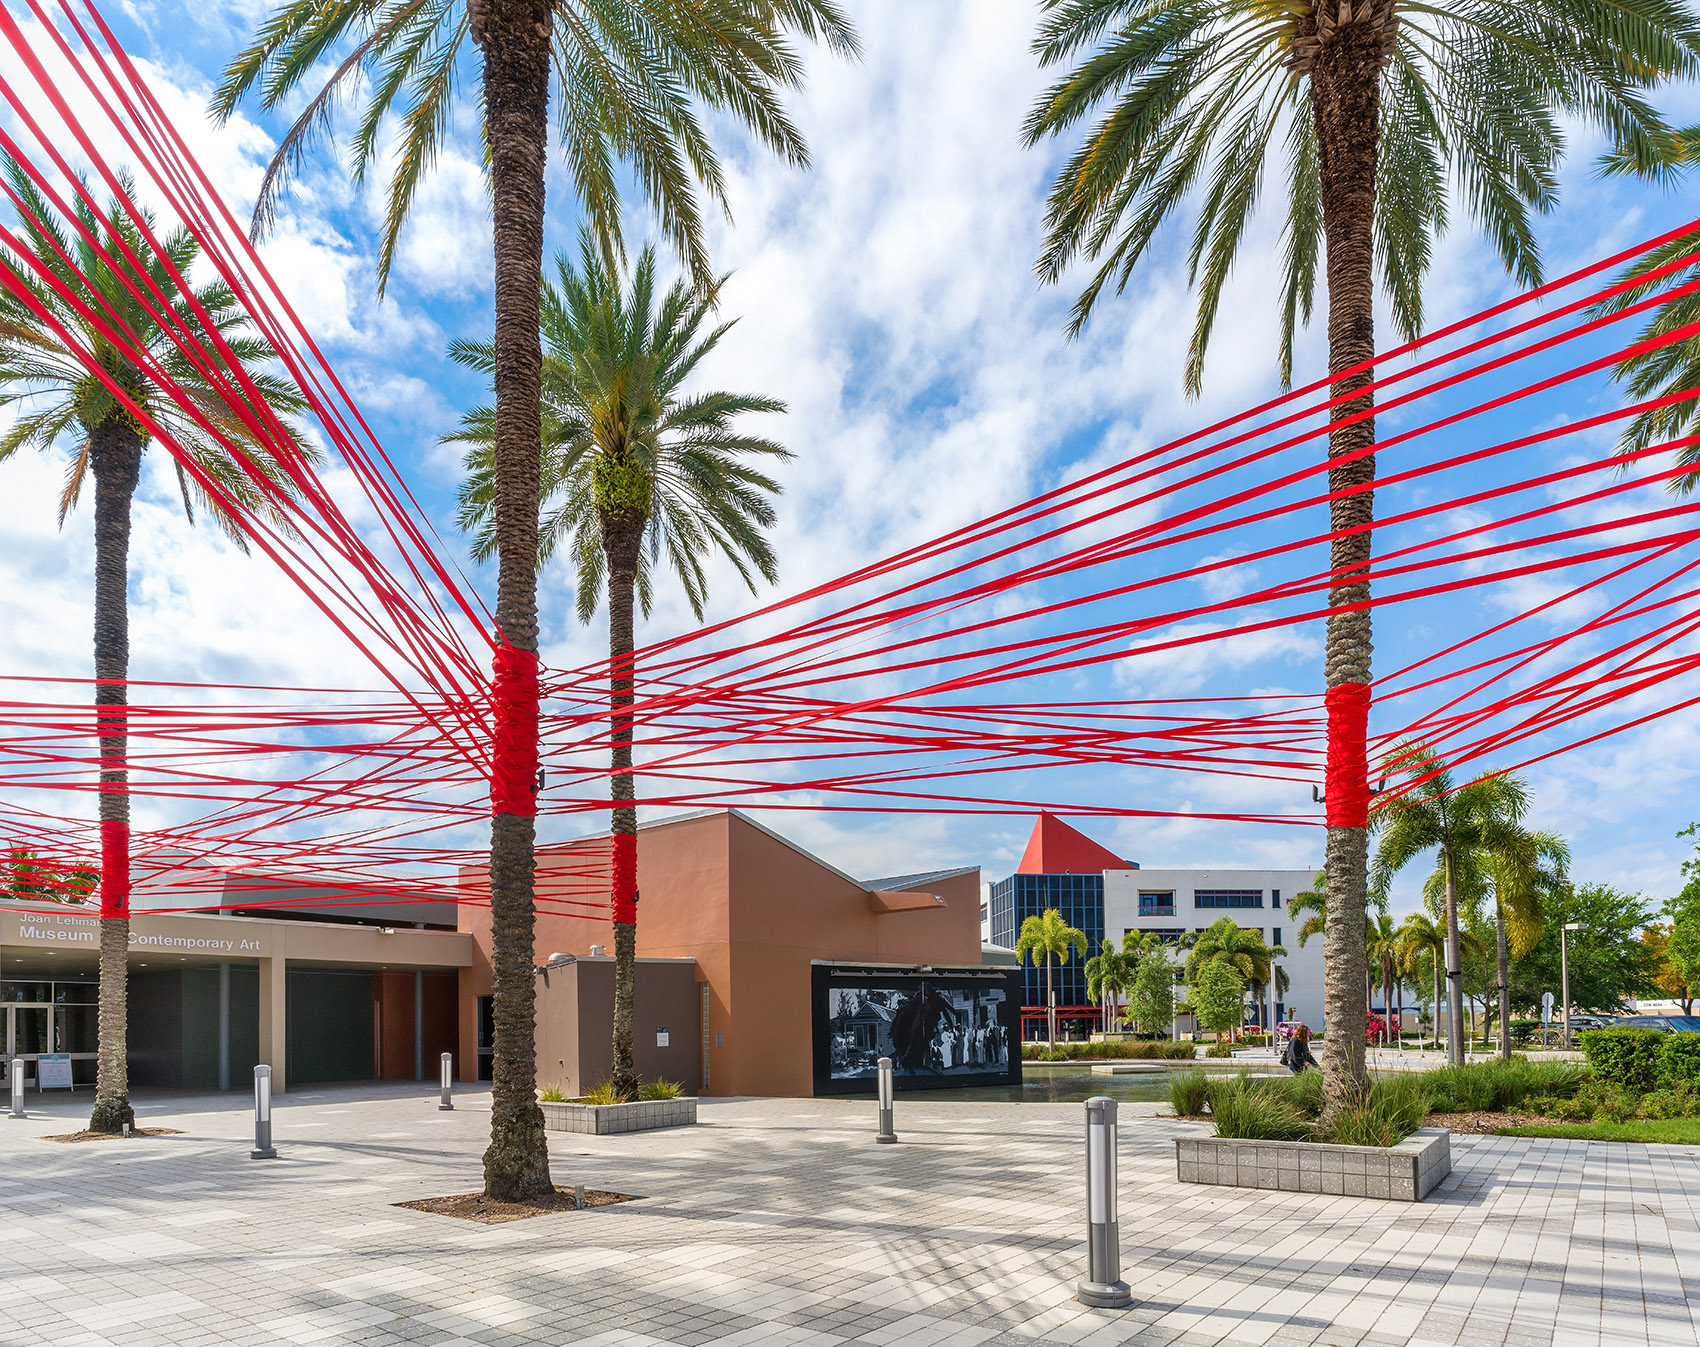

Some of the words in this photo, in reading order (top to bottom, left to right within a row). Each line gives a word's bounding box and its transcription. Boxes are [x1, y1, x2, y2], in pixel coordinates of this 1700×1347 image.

[20, 913, 51, 923] Joan
[19, 925, 94, 942] Museum
[127, 932, 234, 951] Contemporary
[239, 938, 261, 950] Art
